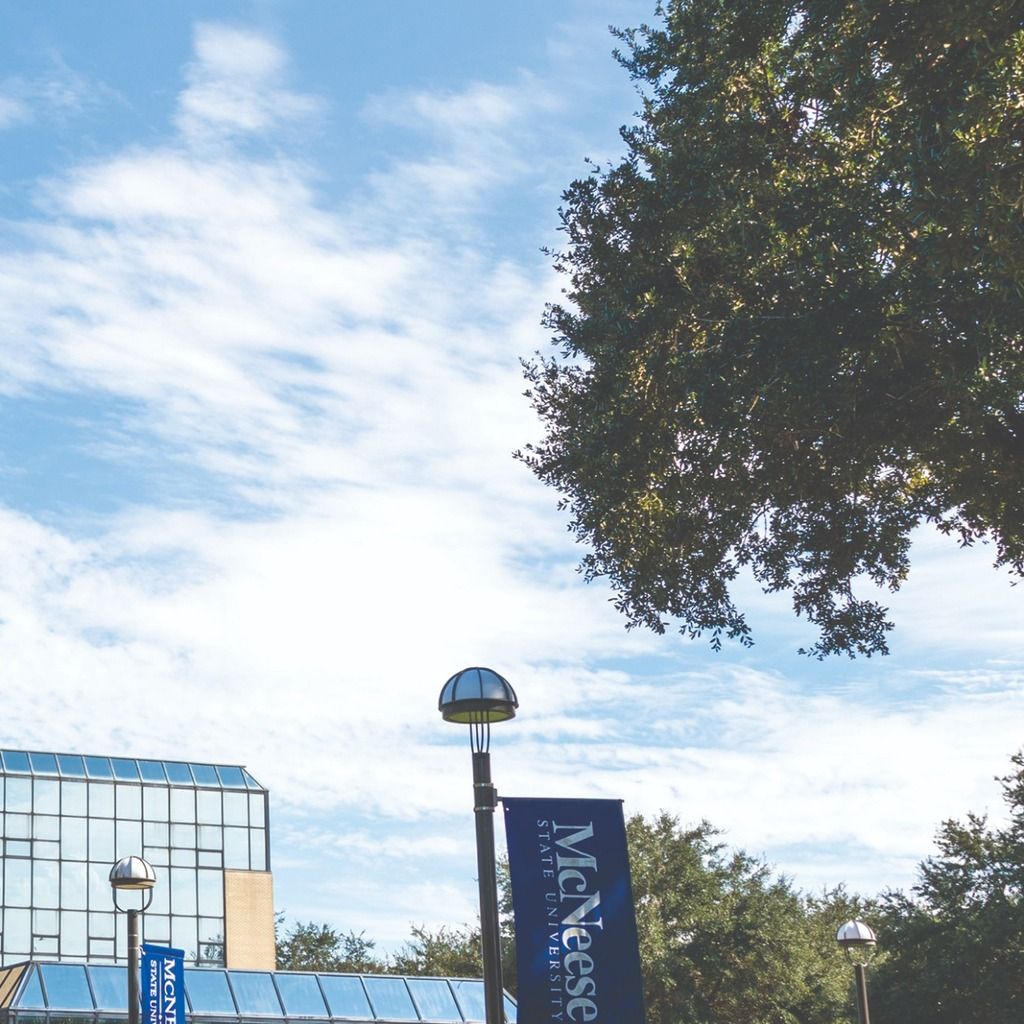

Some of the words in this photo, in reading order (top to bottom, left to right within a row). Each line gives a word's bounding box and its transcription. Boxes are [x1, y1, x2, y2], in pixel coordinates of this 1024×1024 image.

[536, 819, 554, 878] STATE
[544, 892, 565, 1022] UNIVERSITY
[552, 820, 603, 1023] McNeese
[149, 959, 158, 997] STATE
